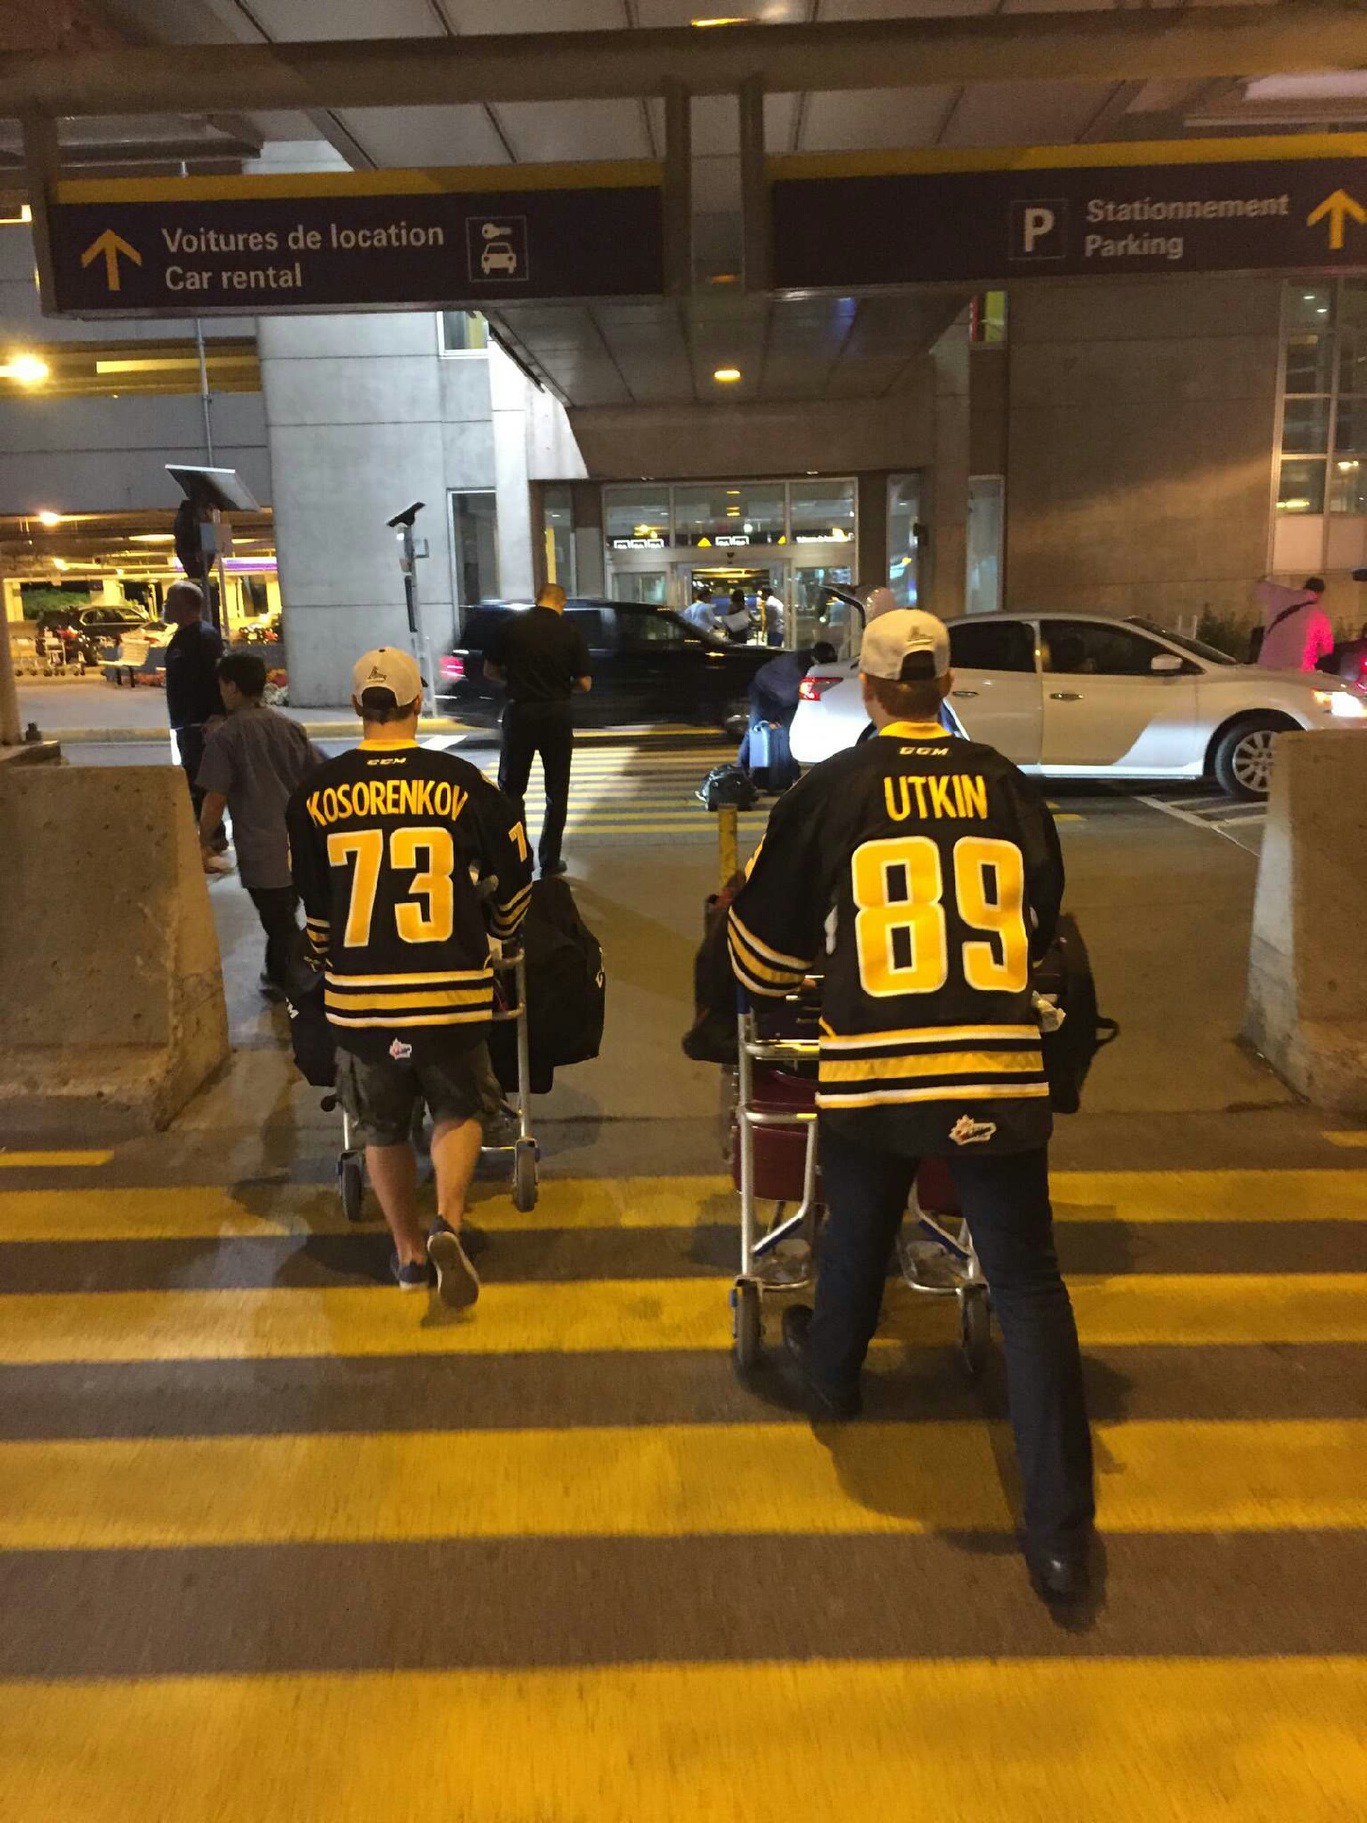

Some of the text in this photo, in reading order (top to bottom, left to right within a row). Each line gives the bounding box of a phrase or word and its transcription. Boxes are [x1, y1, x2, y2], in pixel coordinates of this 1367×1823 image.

[1023, 207, 1054, 252] P
[1086, 193, 1290, 223] Stationnement
[162, 222, 444, 253] Voitures de location
[1084, 233, 1184, 260] Parking
[165, 263, 302, 291] Car rental
[306, 778, 469, 828] KOSORENKOV
[883, 774, 989, 822] UTKIN
[326, 827, 455, 948] 73
[851, 835, 1029, 998] 89
